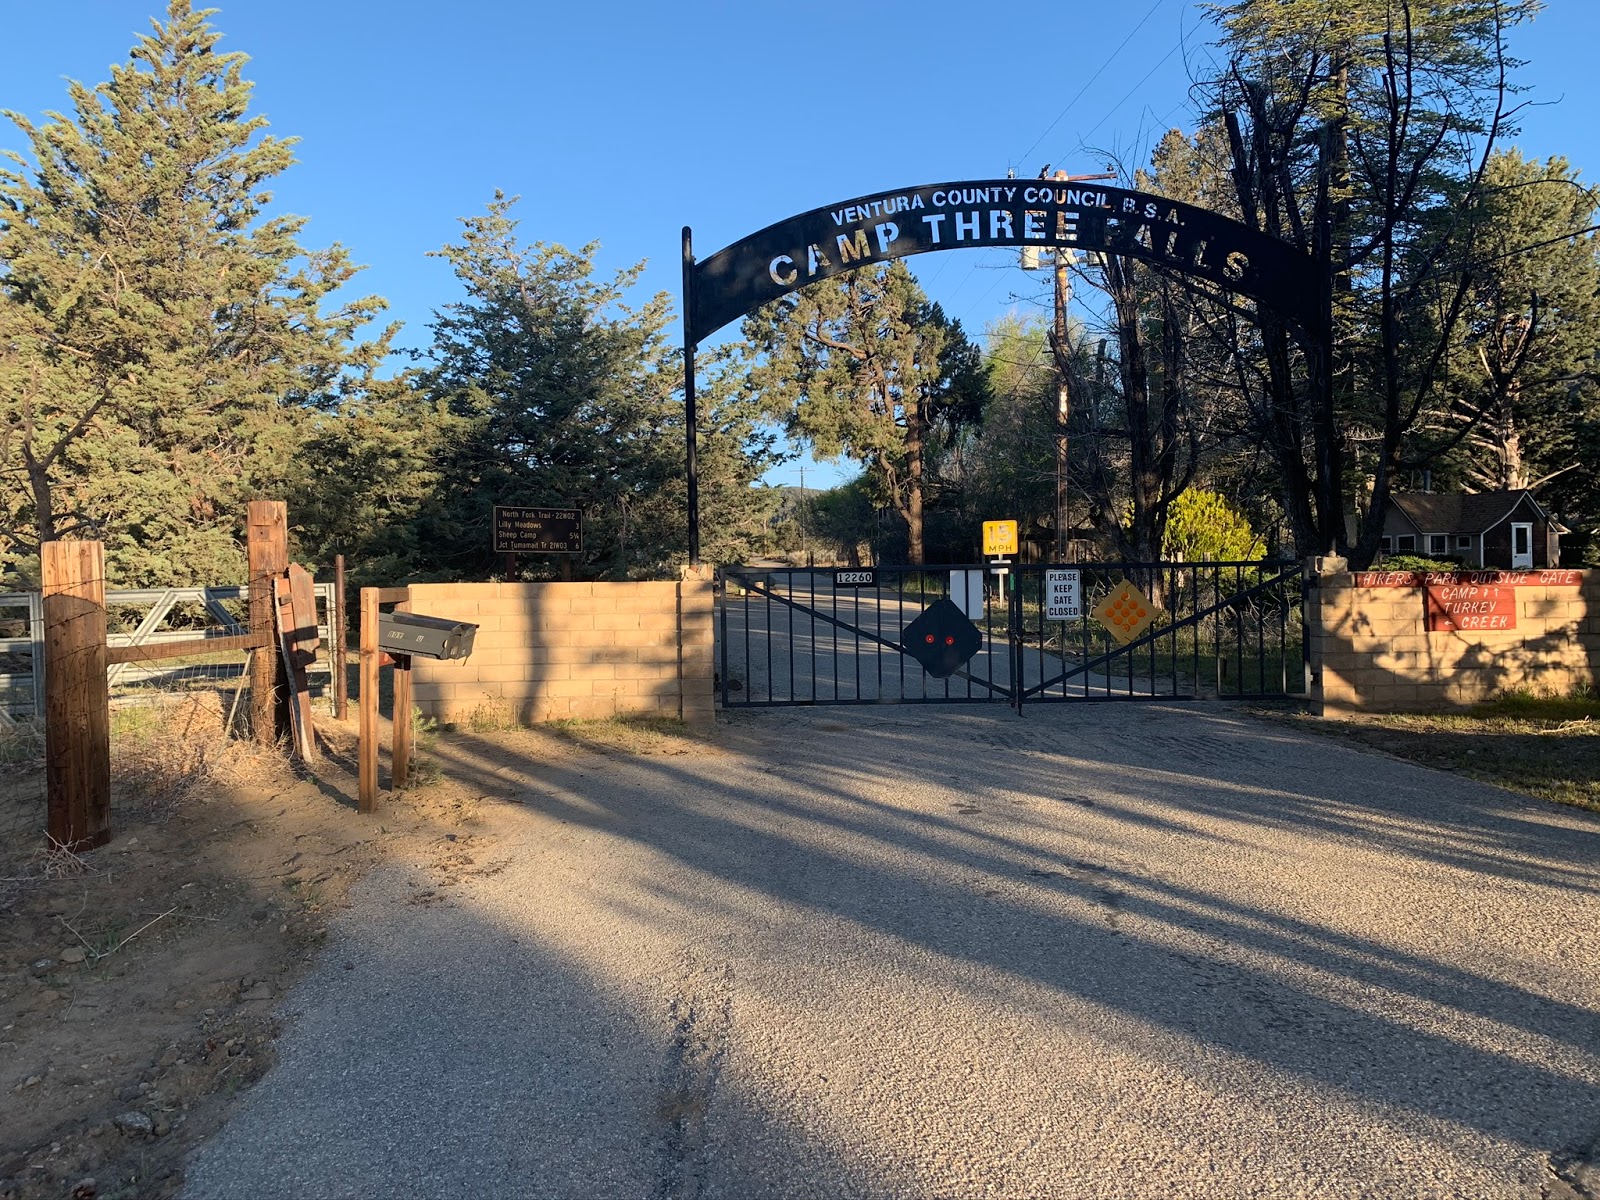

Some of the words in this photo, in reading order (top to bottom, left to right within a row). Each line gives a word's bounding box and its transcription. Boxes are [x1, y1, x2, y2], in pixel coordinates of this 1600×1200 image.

[831, 193, 924, 226] VENTURA
[932, 187, 1018, 207] COUNTY
[769, 221, 900, 286] CAMP
[922, 209, 1079, 244] THREE
[1104, 216, 1250, 281] FALLS
[502, 510, 519, 518] North
[538, 511, 551, 519] Trail
[499, 520, 511, 529] Lilly
[499, 530, 517, 539] Sheep
[520, 531, 536, 539] Camp
[988, 525, 1011, 541] 15
[988, 544, 1012, 552] MPH
[838, 573, 872, 582] 12260
[1049, 573, 1077, 581] PLEASE
[1363, 572, 1413, 585] HIKERS
[1424, 572, 1459, 585] PARK
[1470, 572, 1528, 585] OUTSIDE
[1540, 571, 1576, 584] GATE
[1053, 584, 1073, 593] KEEP
[1441, 587, 1478, 600] CAMP
[1053, 596, 1072, 605] GATE
[1049, 607, 1078, 616] CLOSED
[1444, 601, 1497, 614] TURKEY
[1461, 616, 1508, 629] CREEK
